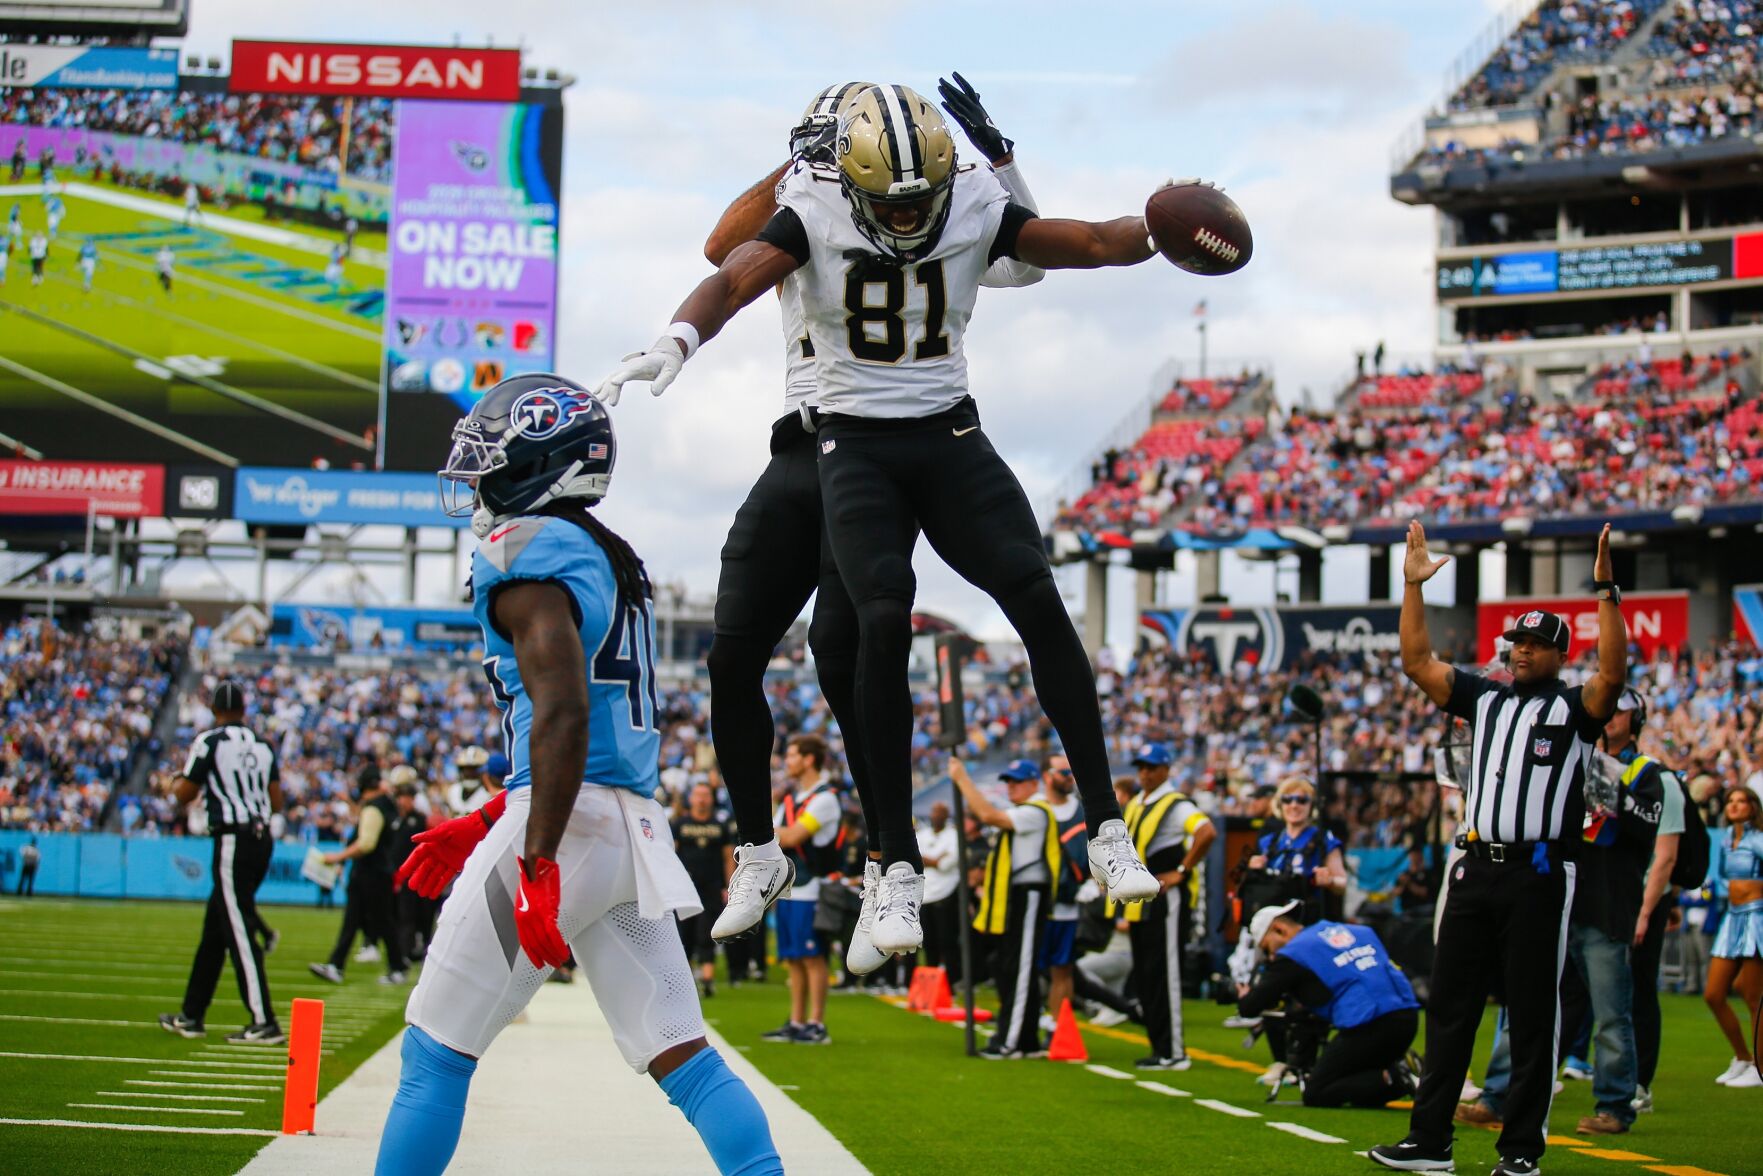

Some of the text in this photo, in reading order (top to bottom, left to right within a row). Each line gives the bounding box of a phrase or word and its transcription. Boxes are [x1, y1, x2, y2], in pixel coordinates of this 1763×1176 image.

[267, 52, 484, 89] NISSAN
[899, 184, 921, 192] SAINTS
[397, 220, 555, 258] ON SALE
[424, 255, 524, 290] NOW
[843, 257, 951, 367] 81
[12, 465, 146, 492] INSURANCE
